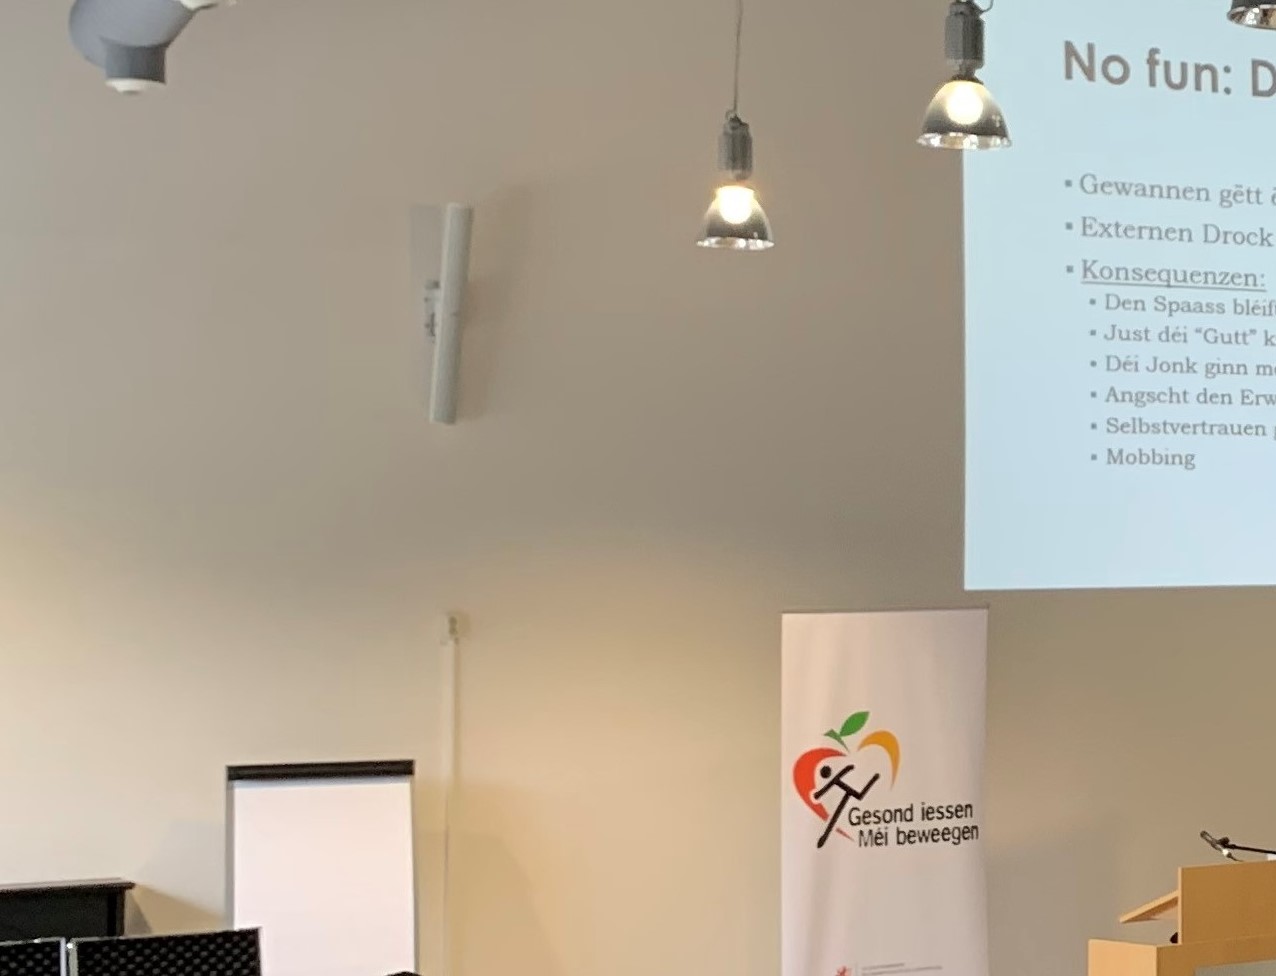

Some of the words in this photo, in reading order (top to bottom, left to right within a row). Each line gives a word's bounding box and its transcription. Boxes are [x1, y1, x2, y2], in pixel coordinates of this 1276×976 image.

[1064, 40, 1130, 85] No
[1146, 47, 1232, 95] fun:
[1079, 173, 1210, 202] Gewannen
[1080, 216, 1194, 243] Externen
[1202, 223, 1273, 248] Drock
[1081, 259, 1266, 289] Konsequenzen:
[1104, 293, 1146, 312] Den
[1153, 295, 1226, 317] Spaass
[1104, 324, 1151, 342] Just
[1158, 326, 1188, 344] déi
[1105, 354, 1140, 373] Déi
[1145, 356, 1198, 375] Jonk
[1204, 358, 1248, 379] ginn
[1105, 386, 1189, 408] Angscht
[1196, 388, 1233, 405] den
[1106, 417, 1267, 437] Selbstvertrauen
[1106, 448, 1196, 471] Mobbing
[848, 803, 913, 826] Gesond
[921, 801, 973, 821] iessen
[858, 826, 889, 847] Méi
[896, 825, 979, 845] beweegen
